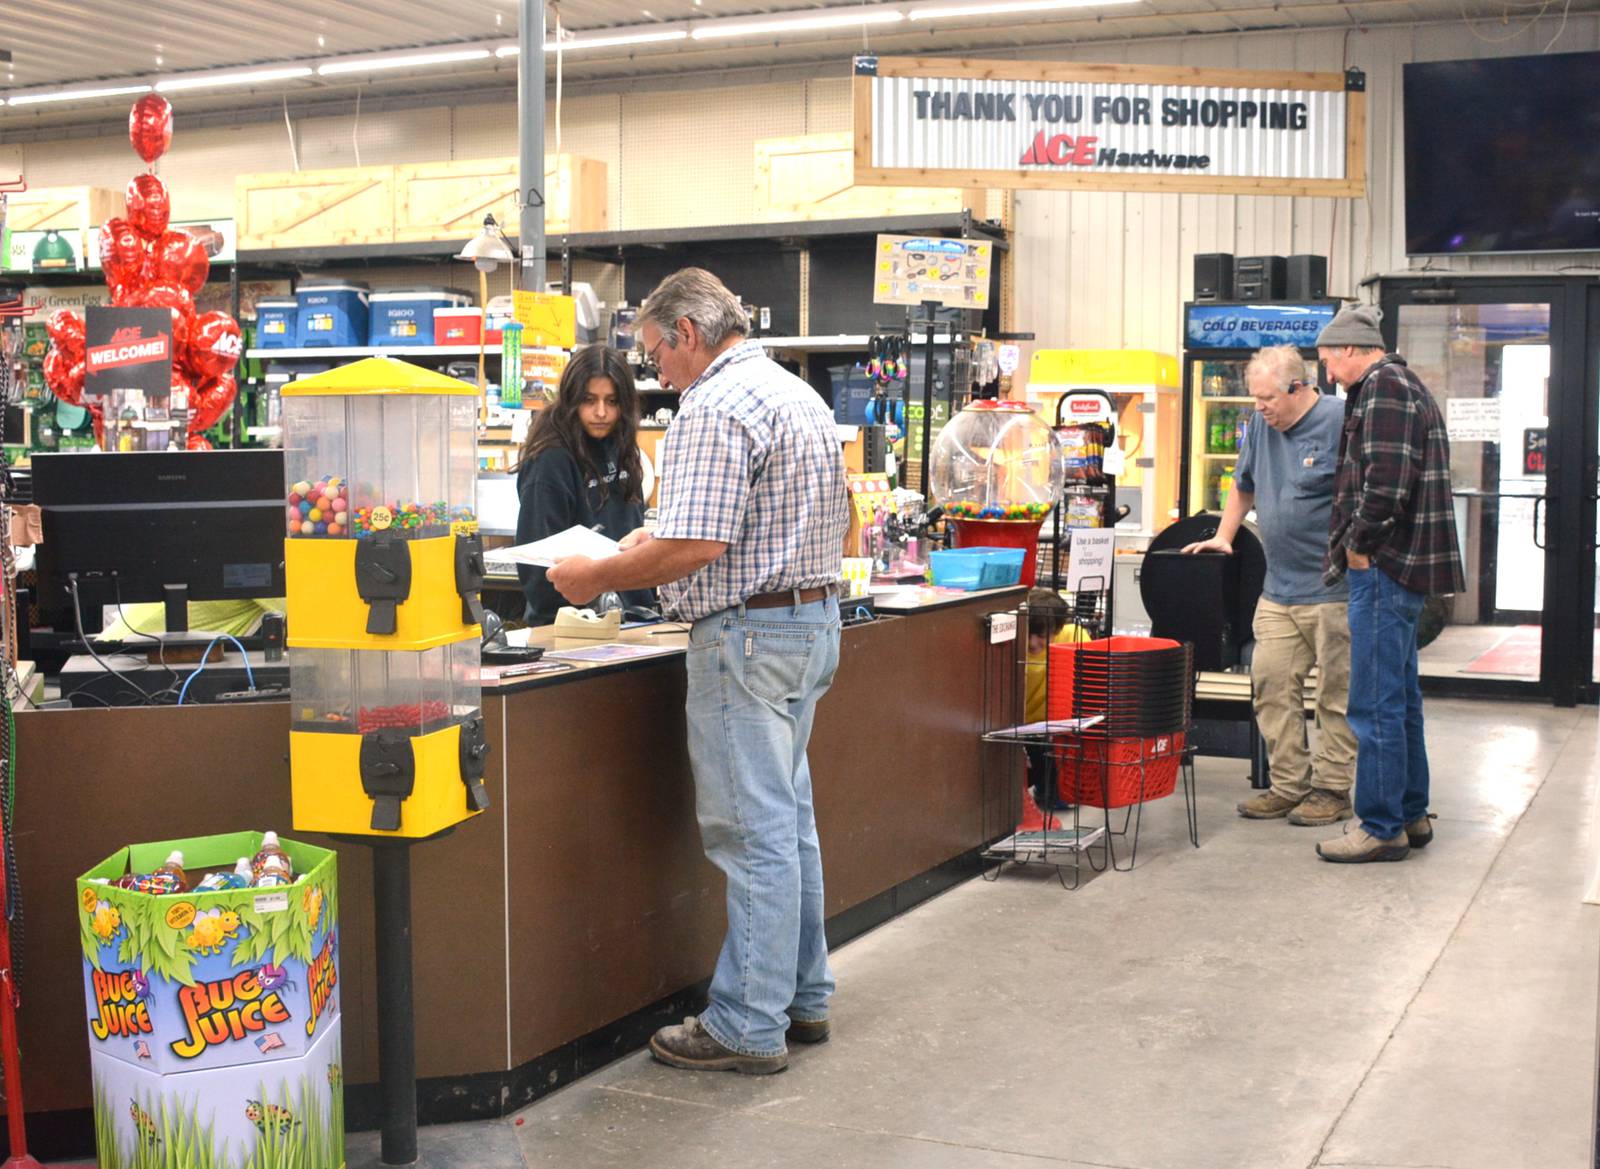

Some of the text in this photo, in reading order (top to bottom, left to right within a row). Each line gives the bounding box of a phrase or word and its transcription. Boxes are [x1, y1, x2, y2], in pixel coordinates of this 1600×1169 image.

[913, 90, 1307, 130] THANK YOU FOR SHOPPING
[1019, 129, 1211, 169] ACE Hardware
[49, 295, 80, 307] Green
[388, 309, 415, 317] IGLOO
[111, 326, 142, 343] ACE
[1202, 320, 1319, 332] COLD BEVERAGES
[91, 341, 164, 365] WELCOME!
[211, 331, 243, 355] ACE
[1076, 537, 1087, 546] Use
[1092, 537, 1110, 545] basket
[92, 967, 138, 1003] BUG
[178, 971, 264, 1017] BUG
[91, 1001, 153, 1041] JUICE
[170, 992, 291, 1060] JUICE
